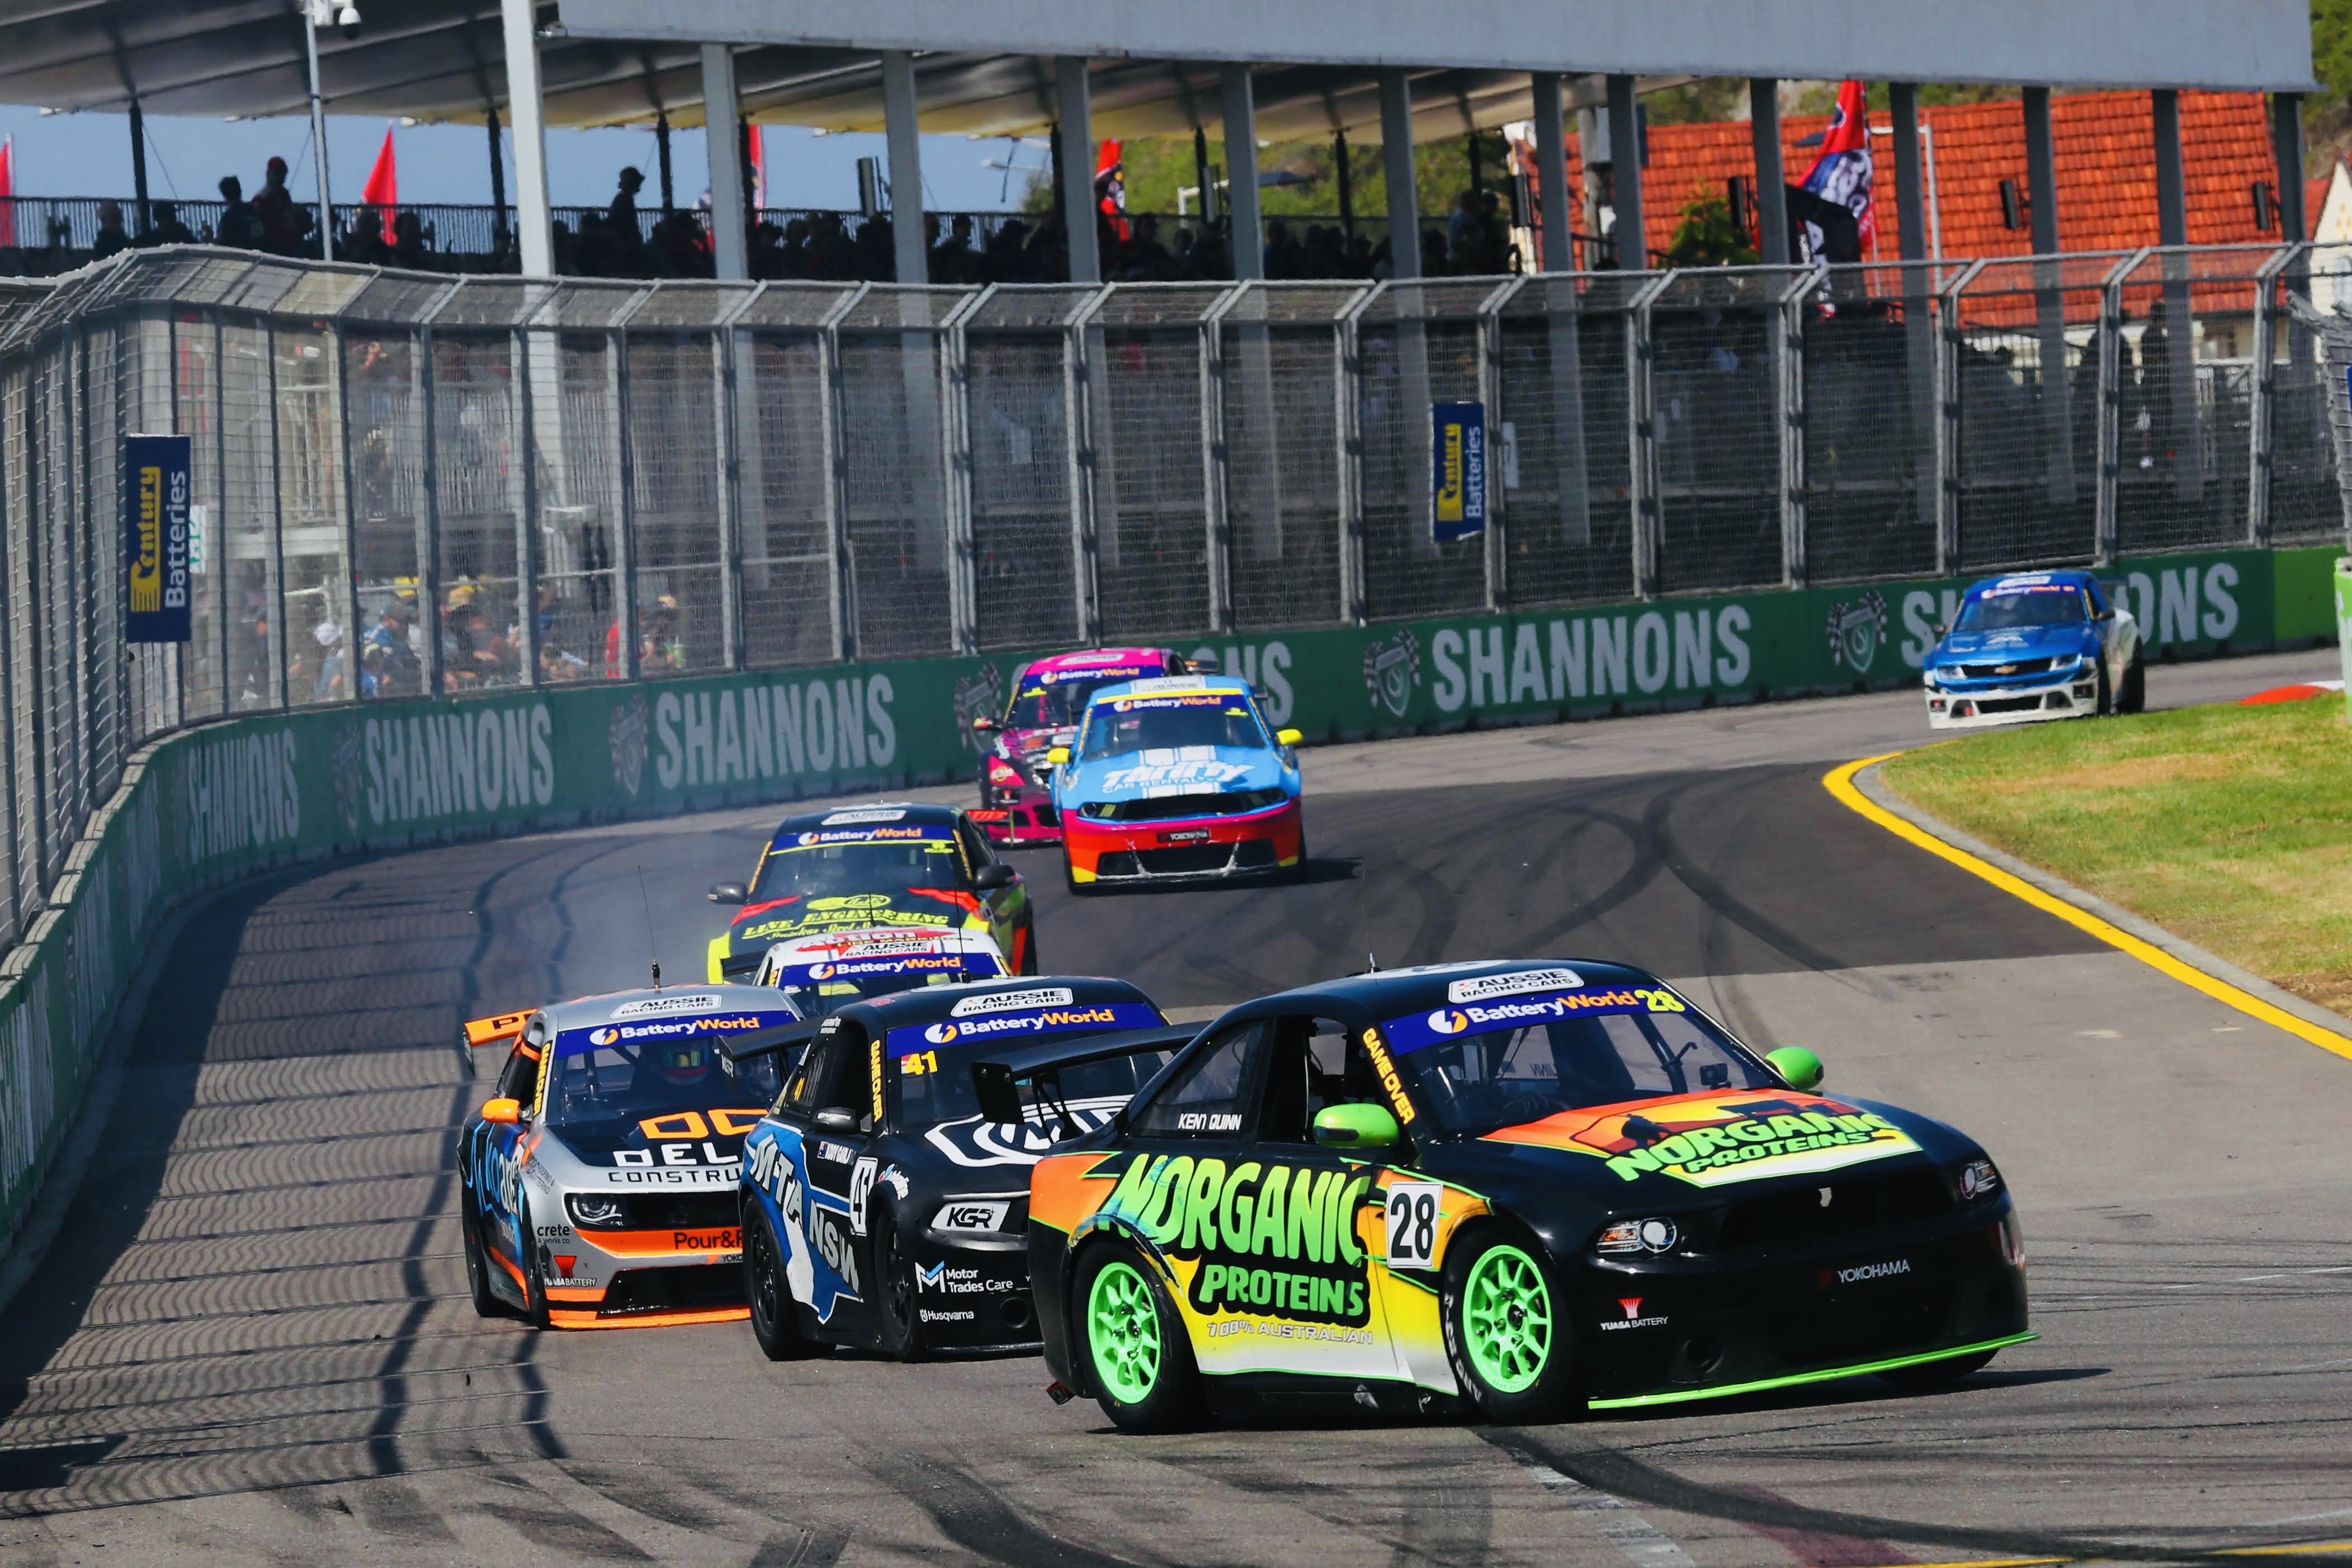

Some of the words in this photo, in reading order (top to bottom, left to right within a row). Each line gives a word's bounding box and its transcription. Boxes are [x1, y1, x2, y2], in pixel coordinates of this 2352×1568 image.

[1437, 423, 1463, 522] Century
[1465, 426, 1482, 517] Batteries
[130, 466, 161, 612] Century
[164, 470, 186, 608] Batteries
[1433, 604, 1752, 712] SHANNONS
[656, 673, 896, 789] SHANNONS
[365, 703, 554, 825] SHANNONS
[188, 728, 299, 866] SHANNONS
[820, 828, 922, 841] BatteryWorld
[803, 909, 949, 925] ENGINEERING
[846, 948, 888, 957] RACING
[863, 942, 929, 951] AUSSIE
[838, 957, 961, 975] BatteryWorld
[1460, 983, 1523, 999] RACING
[1533, 977, 1574, 989] CARS
[1477, 970, 1566, 989] AUSSIE
[639, 996, 714, 1008] AUSSIE
[962, 1001, 1021, 1012] RACING
[1024, 996, 1065, 1005] CARS
[981, 990, 1063, 1004] AUSSIE
[1465, 990, 1640, 1024] BatteryWorld
[1634, 989, 1685, 1012] 28
[622, 1004, 672, 1014] RACING
[620, 1017, 760, 1038] BatteryWorld
[959, 1009, 1115, 1035] BatteryWorld
[906, 1050, 938, 1075] 41
[1178, 1113, 1207, 1130] KENT
[1208, 1113, 1242, 1131] QUINN
[1605, 1112, 1902, 1182] NORGANIC
[1685, 1131, 1872, 1173] PROTEINS
[608, 1168, 742, 1183] CONSTRU
[750, 1134, 804, 1227] MTA
[947, 1207, 994, 1229] KGR
[1099, 1153, 1371, 1268] NORGANIC
[537, 1224, 570, 1237] crete
[1390, 1193, 1435, 1259] 28
[721, 1254, 743, 1263] YOKO
[946, 1268, 979, 1280] Motor
[1838, 1259, 1911, 1283] YOKOHAMA
[565, 1278, 597, 1287] BATTERY
[947, 1281, 984, 1293] Trades
[986, 1279, 1013, 1291] Care
[1199, 1264, 1364, 1316] PROTEINS
[928, 1310, 975, 1322] Husqvarna
[1600, 1319, 1631, 1331] YUASA
[1632, 1315, 1668, 1328] BATTERY
[1207, 1320, 1255, 1338] 100%
[1258, 1321, 1373, 1345] AUSTRALIAN
